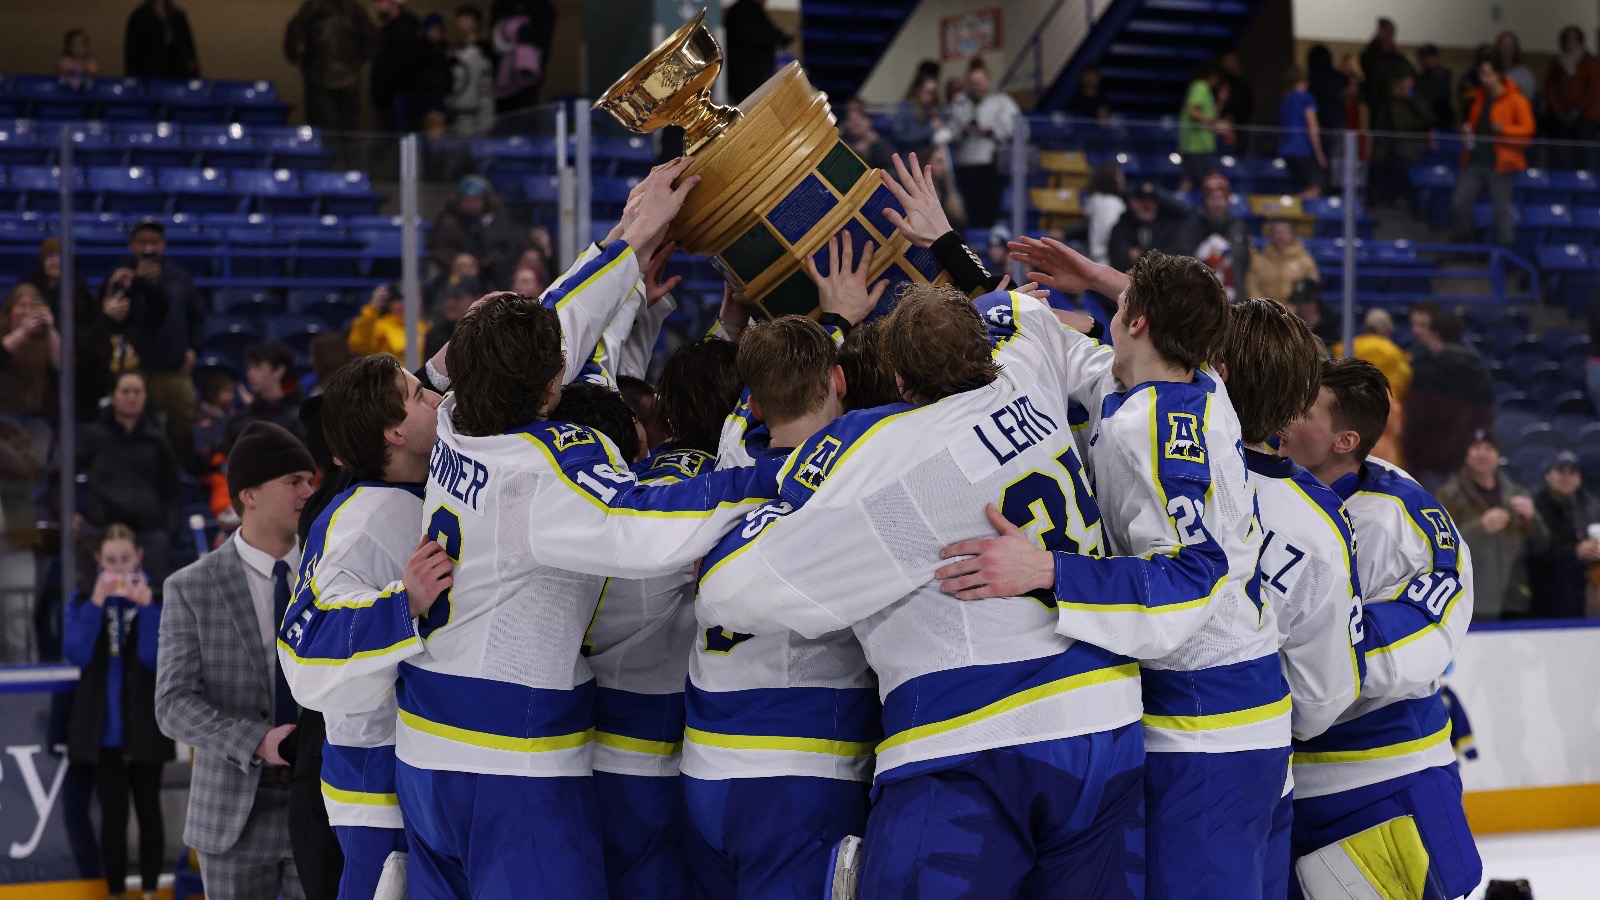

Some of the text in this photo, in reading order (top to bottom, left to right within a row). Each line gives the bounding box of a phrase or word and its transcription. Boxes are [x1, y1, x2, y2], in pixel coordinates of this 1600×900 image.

[972, 395, 1059, 466] LEHTI
[1166, 495, 1208, 545] 2
[1407, 571, 1457, 616] 50
